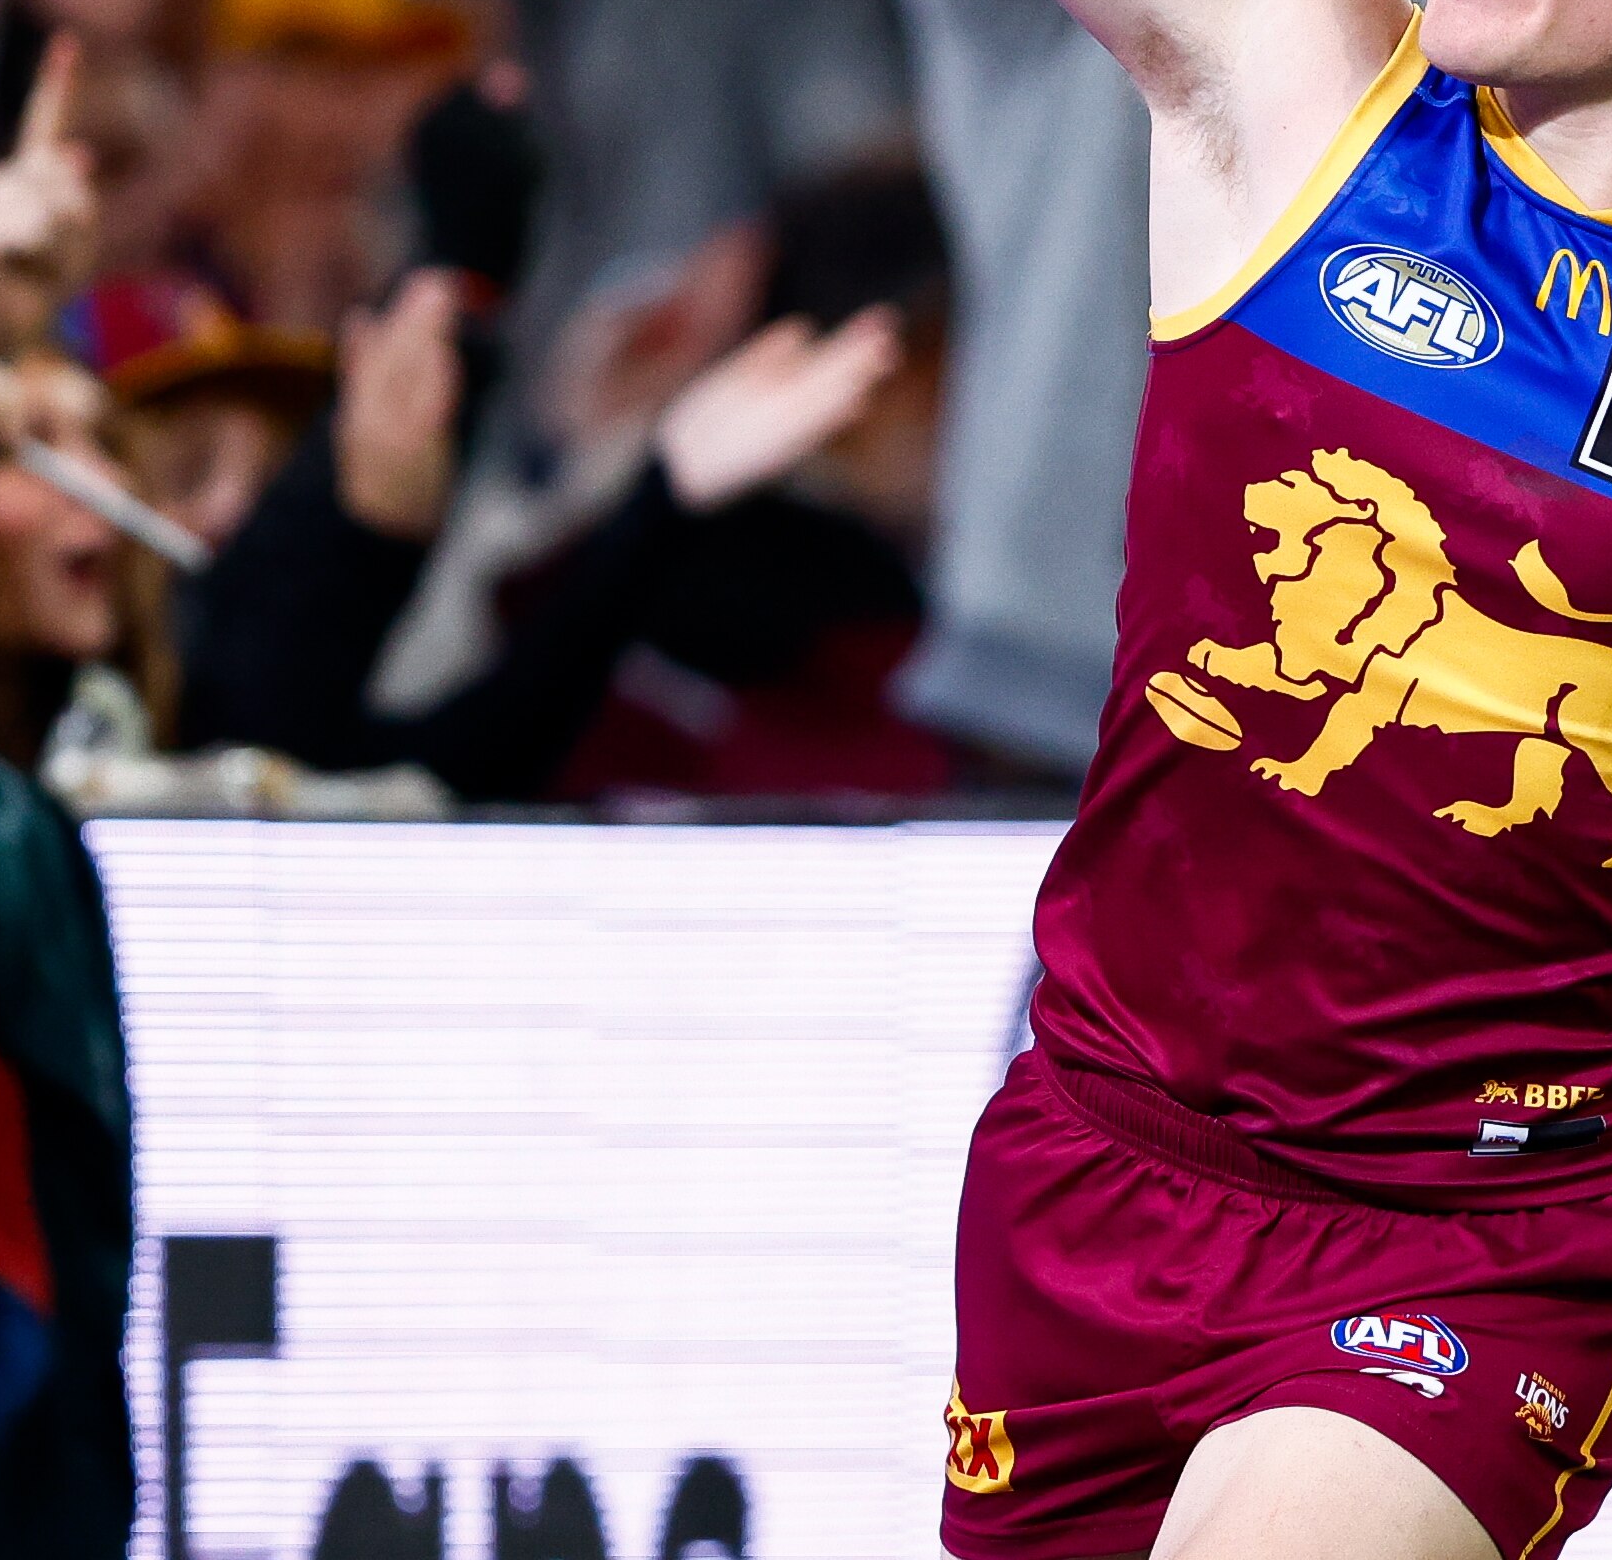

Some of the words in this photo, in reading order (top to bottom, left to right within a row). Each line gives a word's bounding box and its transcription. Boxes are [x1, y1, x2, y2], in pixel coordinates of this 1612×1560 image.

[1330, 258, 1477, 360] AFL
[1343, 1315, 1455, 1371] AFL
[1515, 1372, 1570, 1429] LIONS
